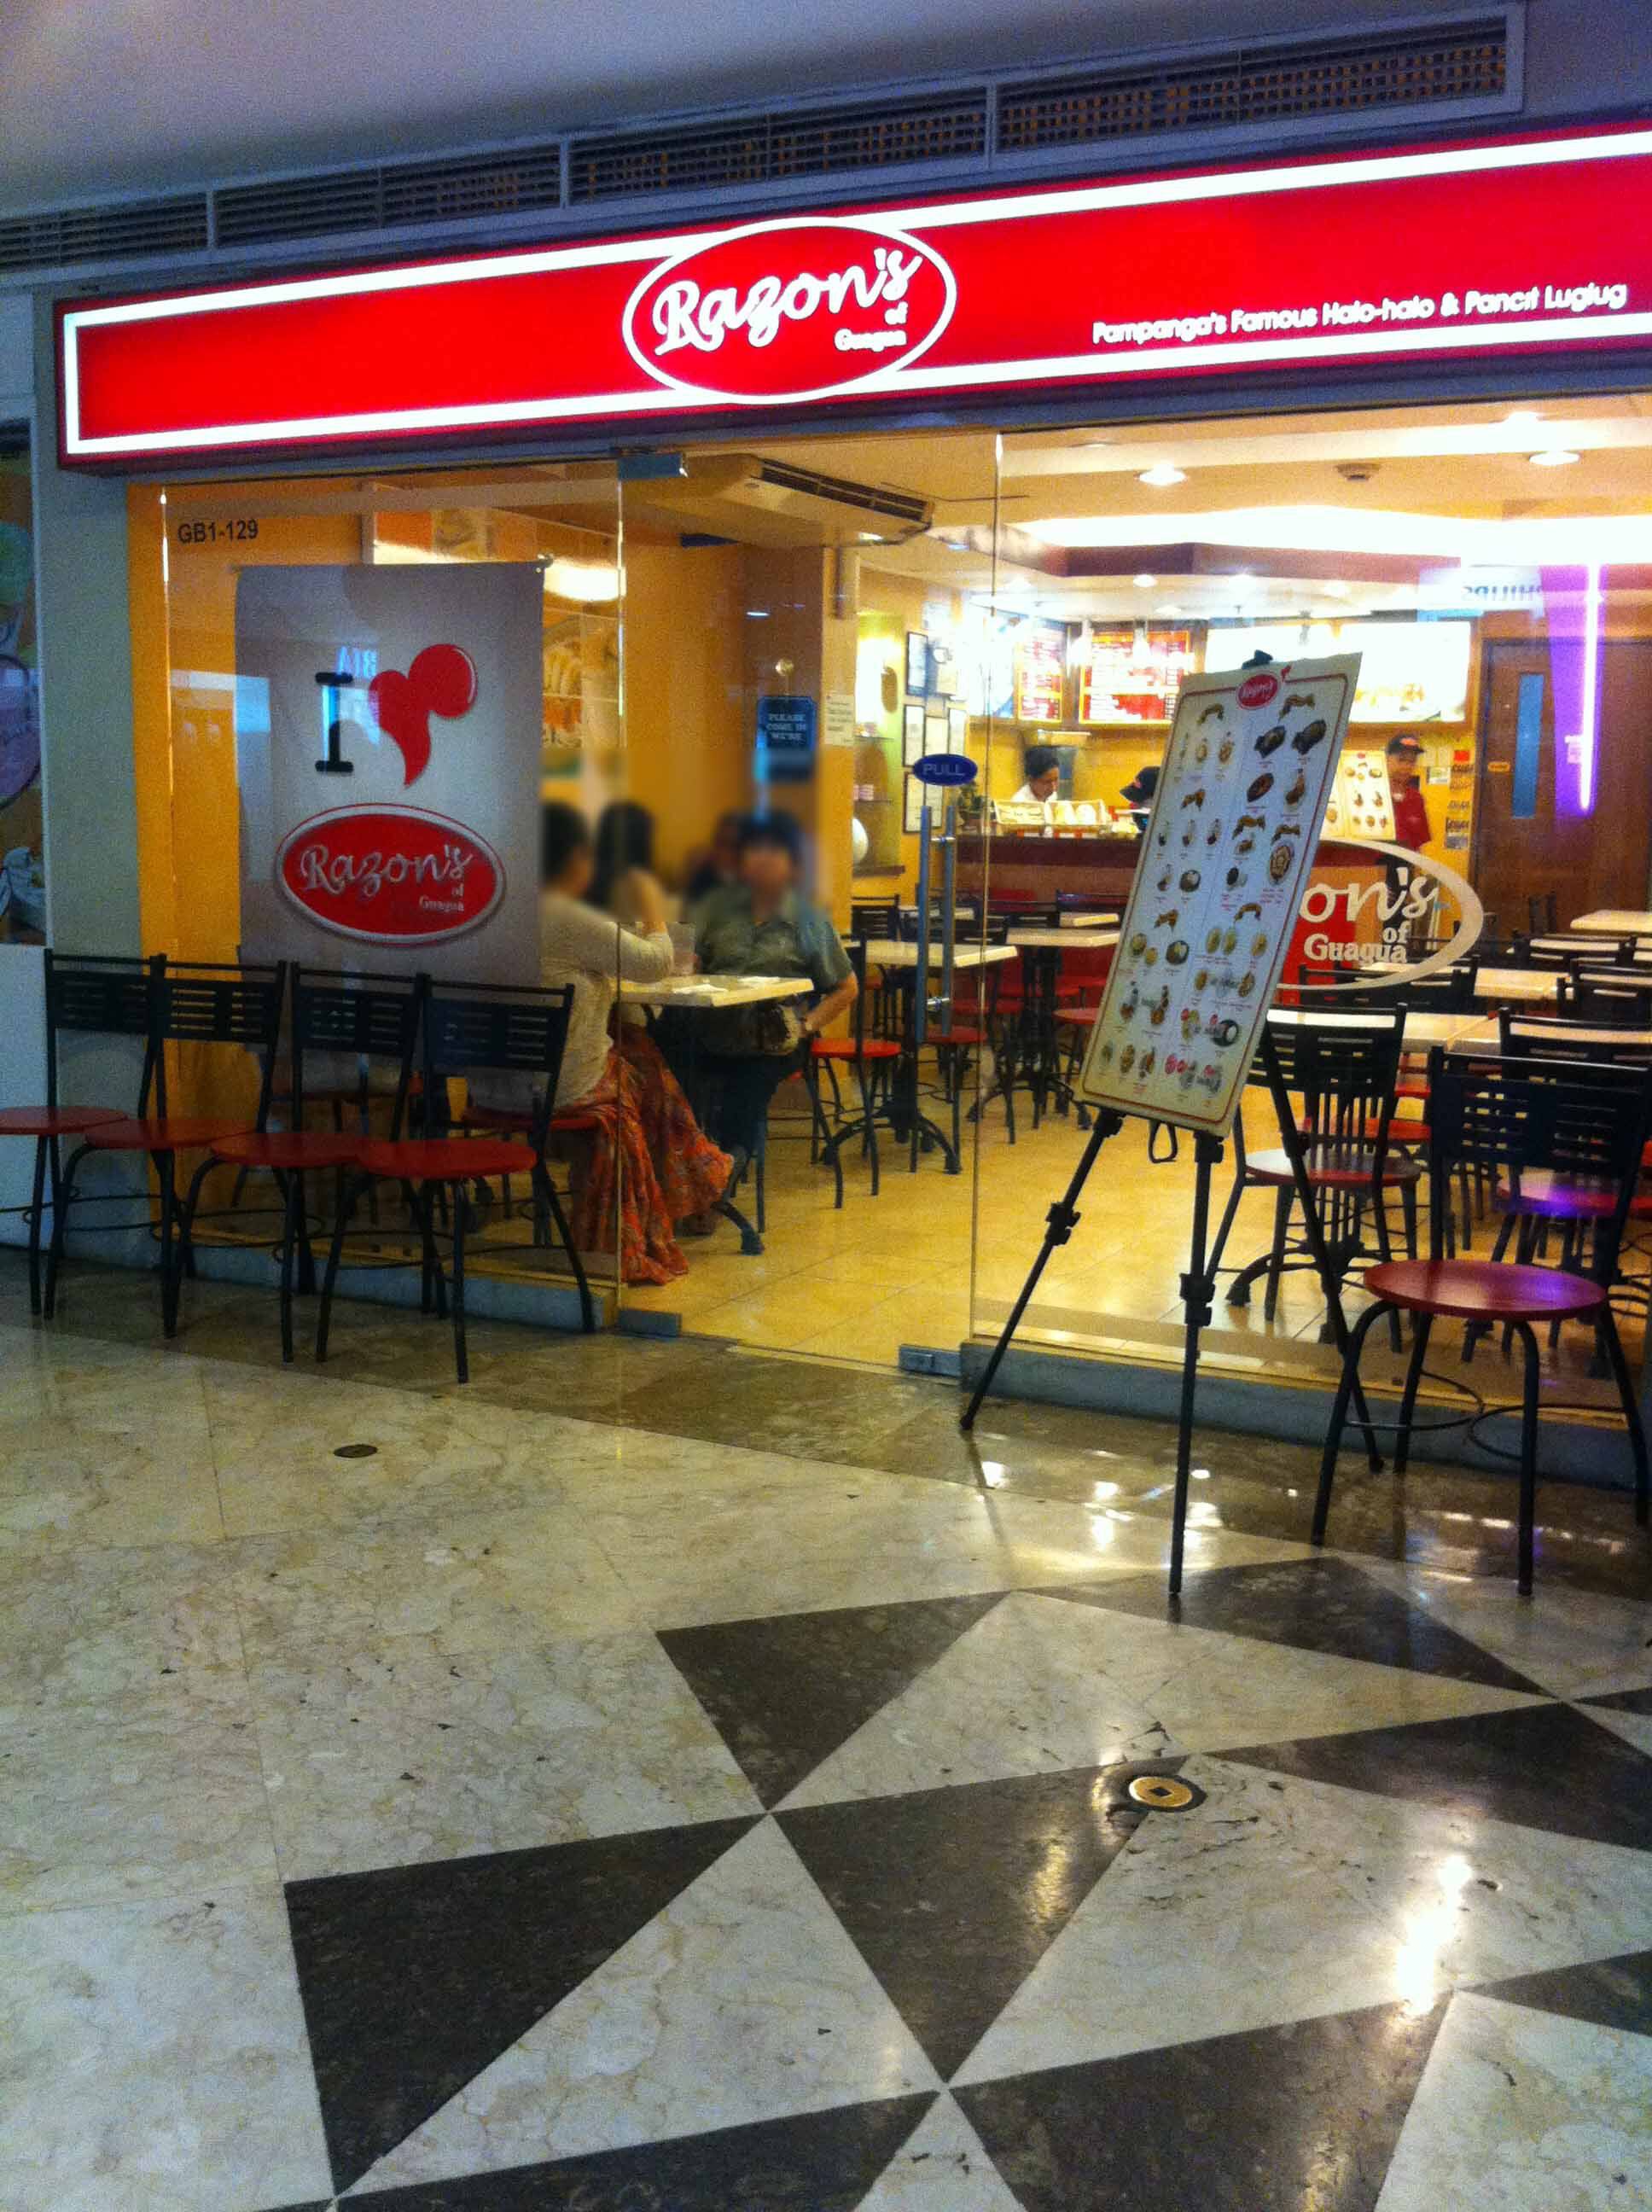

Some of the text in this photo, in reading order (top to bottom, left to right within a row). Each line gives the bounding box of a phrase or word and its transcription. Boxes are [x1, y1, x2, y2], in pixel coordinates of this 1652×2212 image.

[653, 247, 922, 355] Razon's
[1093, 312, 1226, 344] Pampanga's
[1231, 309, 1318, 333] Famous
[1323, 295, 1434, 326] Halo-halo
[1440, 293, 1459, 317] &
[1465, 287, 1539, 314] Pancit
[177, 518, 259, 544] GB1-129
[922, 763, 966, 777] PULL
[300, 844, 473, 896] Razon's
[1299, 866, 1439, 923] on's
[1304, 933, 1407, 963] Guagua
[1382, 921, 1411, 944] of
